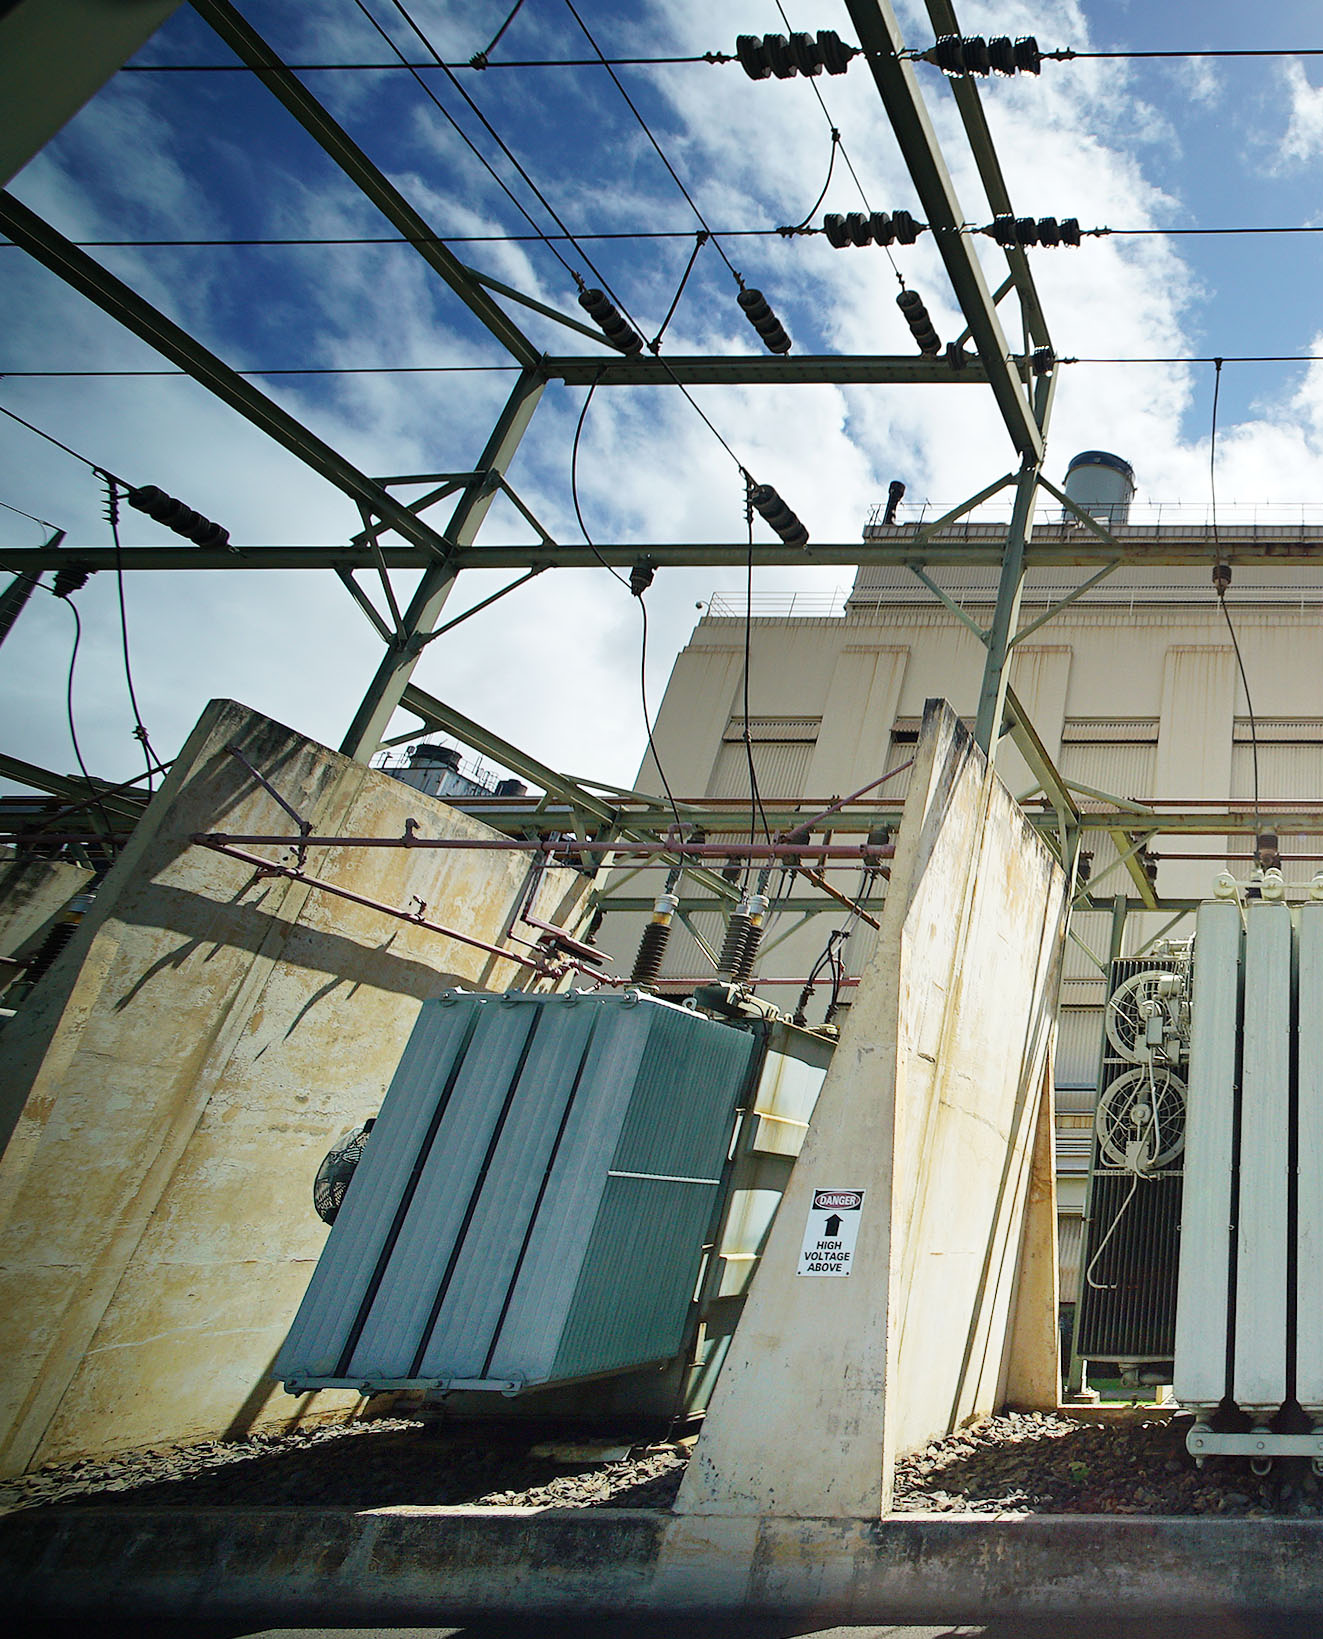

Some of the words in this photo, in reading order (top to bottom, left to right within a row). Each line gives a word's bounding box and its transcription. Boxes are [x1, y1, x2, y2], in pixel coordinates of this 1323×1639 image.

[819, 1195, 857, 1206] DANGER
[816, 1241, 842, 1250] HIGH
[804, 1251, 851, 1261] VOLTAGE
[806, 1263, 843, 1272] ABOVE
